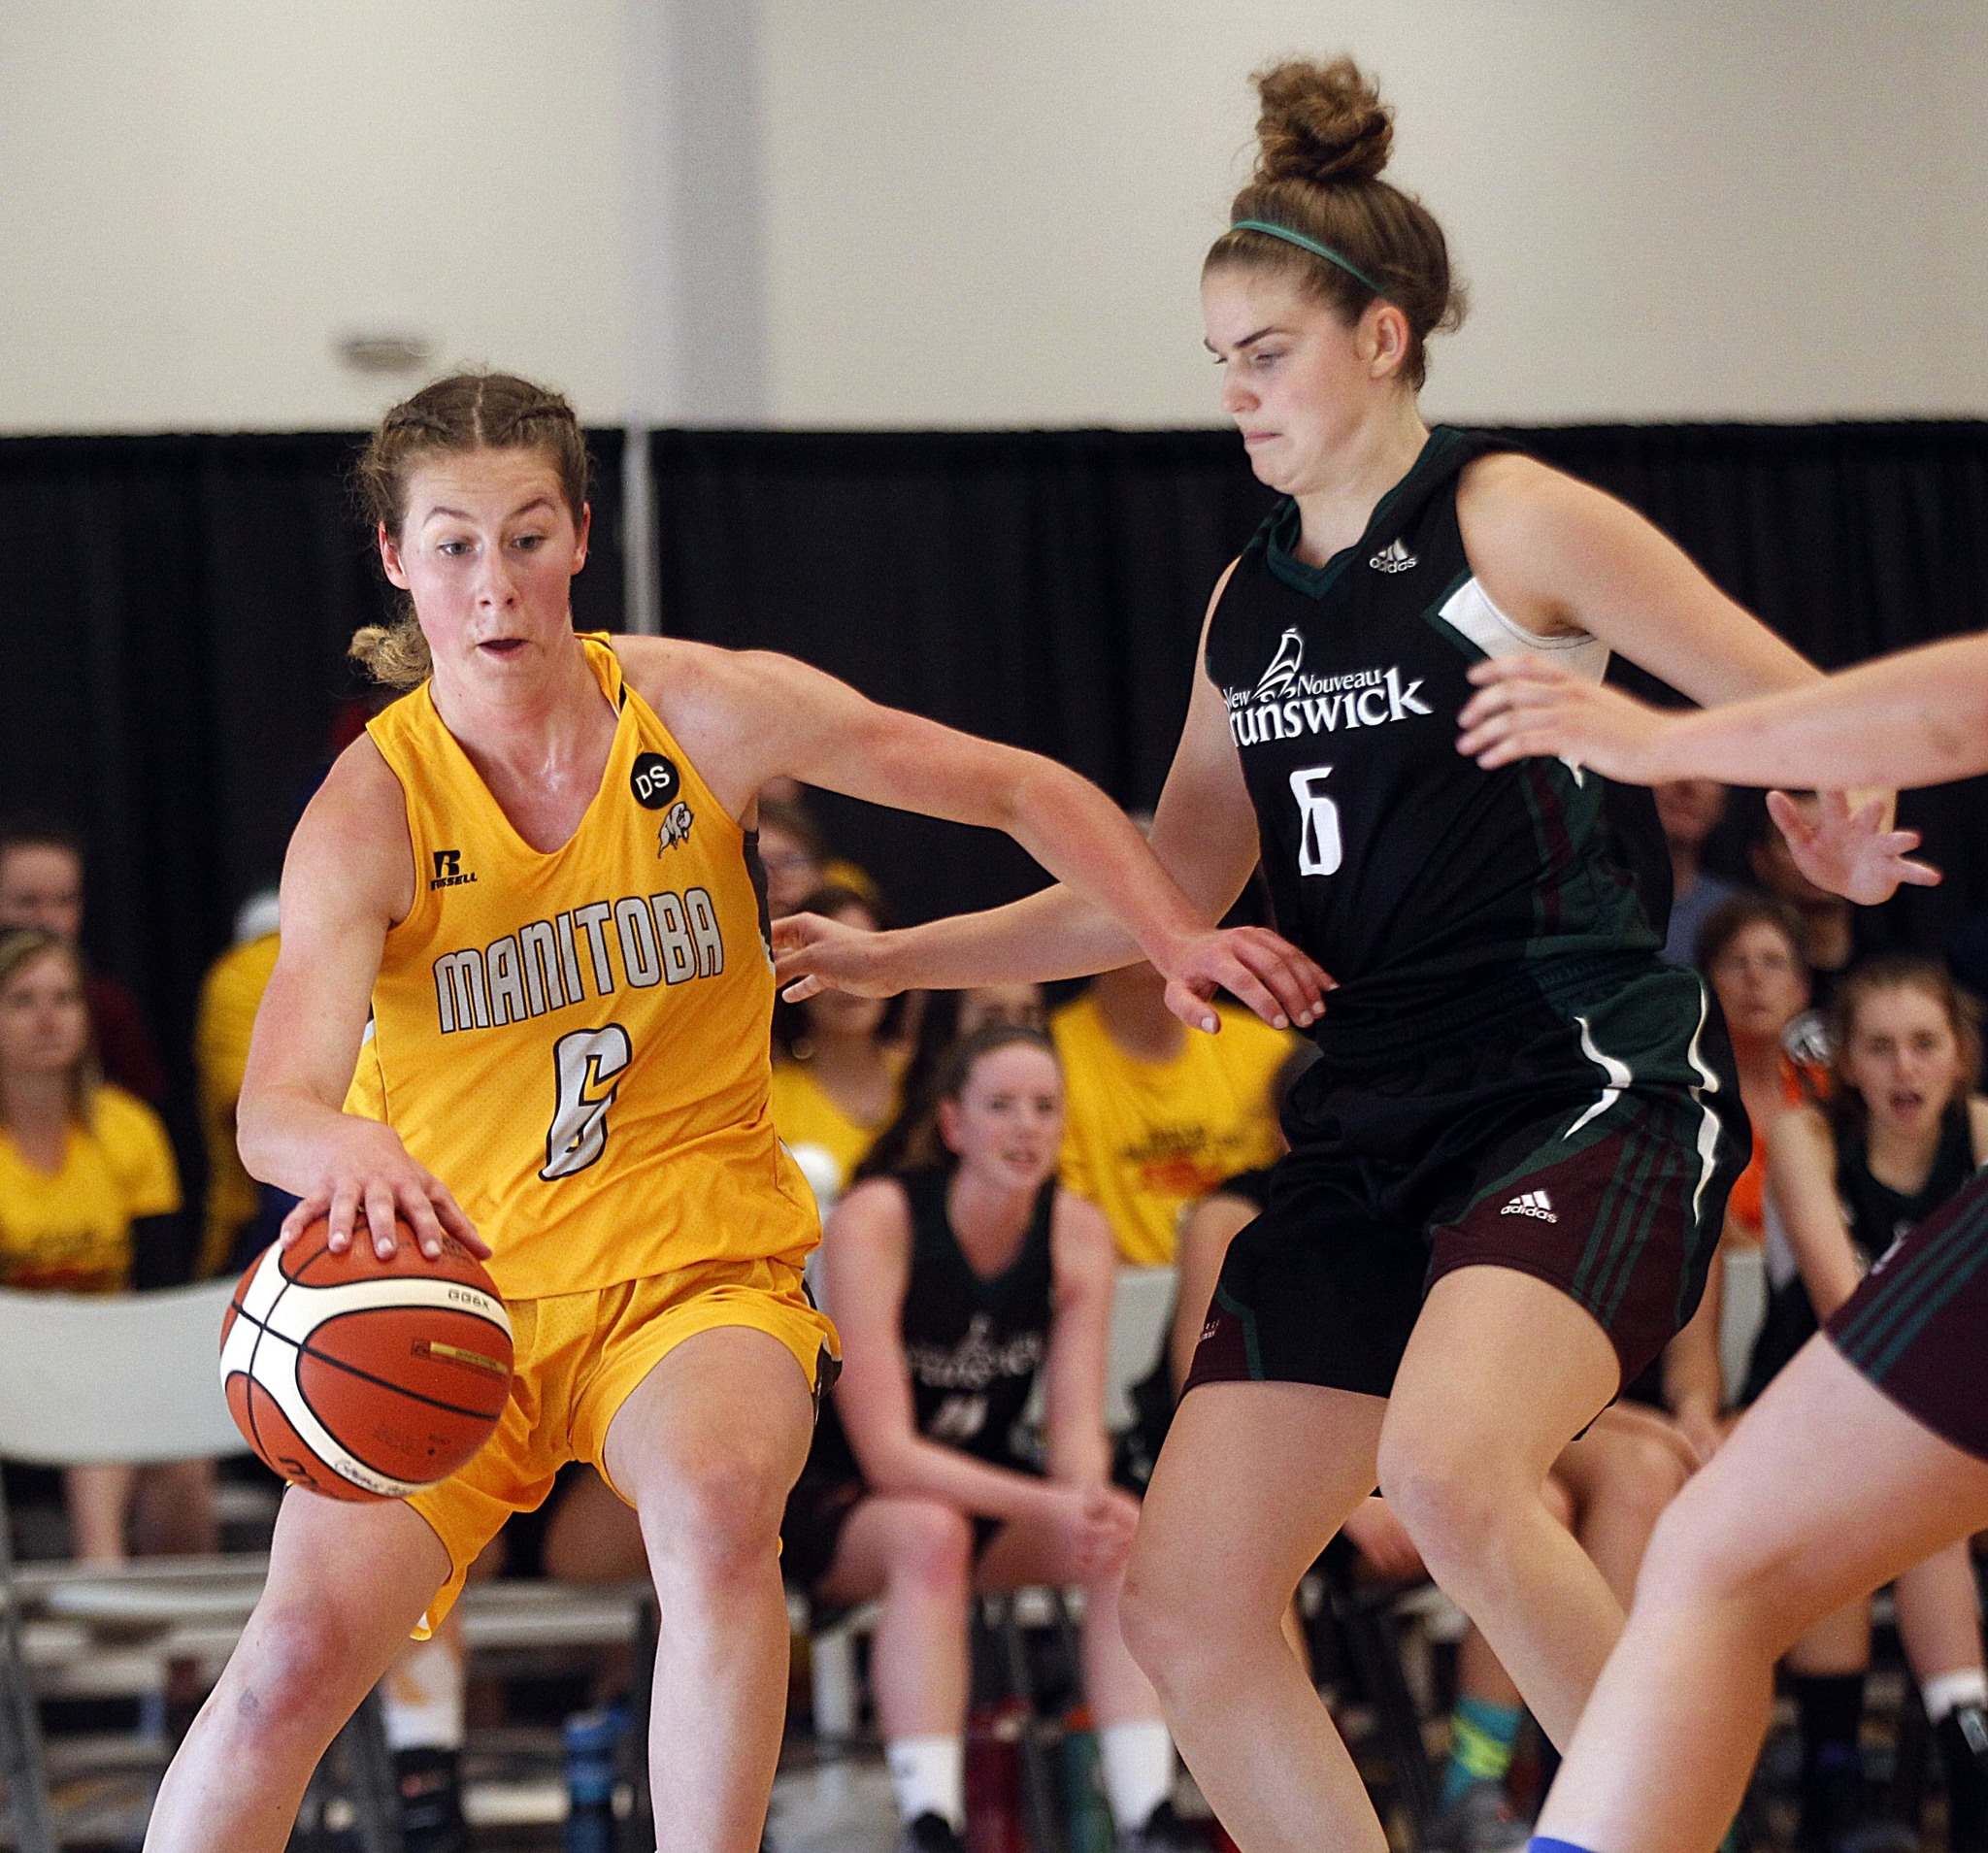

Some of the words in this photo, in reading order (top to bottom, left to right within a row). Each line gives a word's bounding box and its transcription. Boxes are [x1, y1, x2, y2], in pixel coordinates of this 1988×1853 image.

[1297, 668, 1382, 699] Nouveau
[1227, 667, 1435, 748] runswick
[635, 765, 671, 801] DS
[432, 887, 724, 1034] MANITOBA
[1500, 1205, 1558, 1224] adidas
